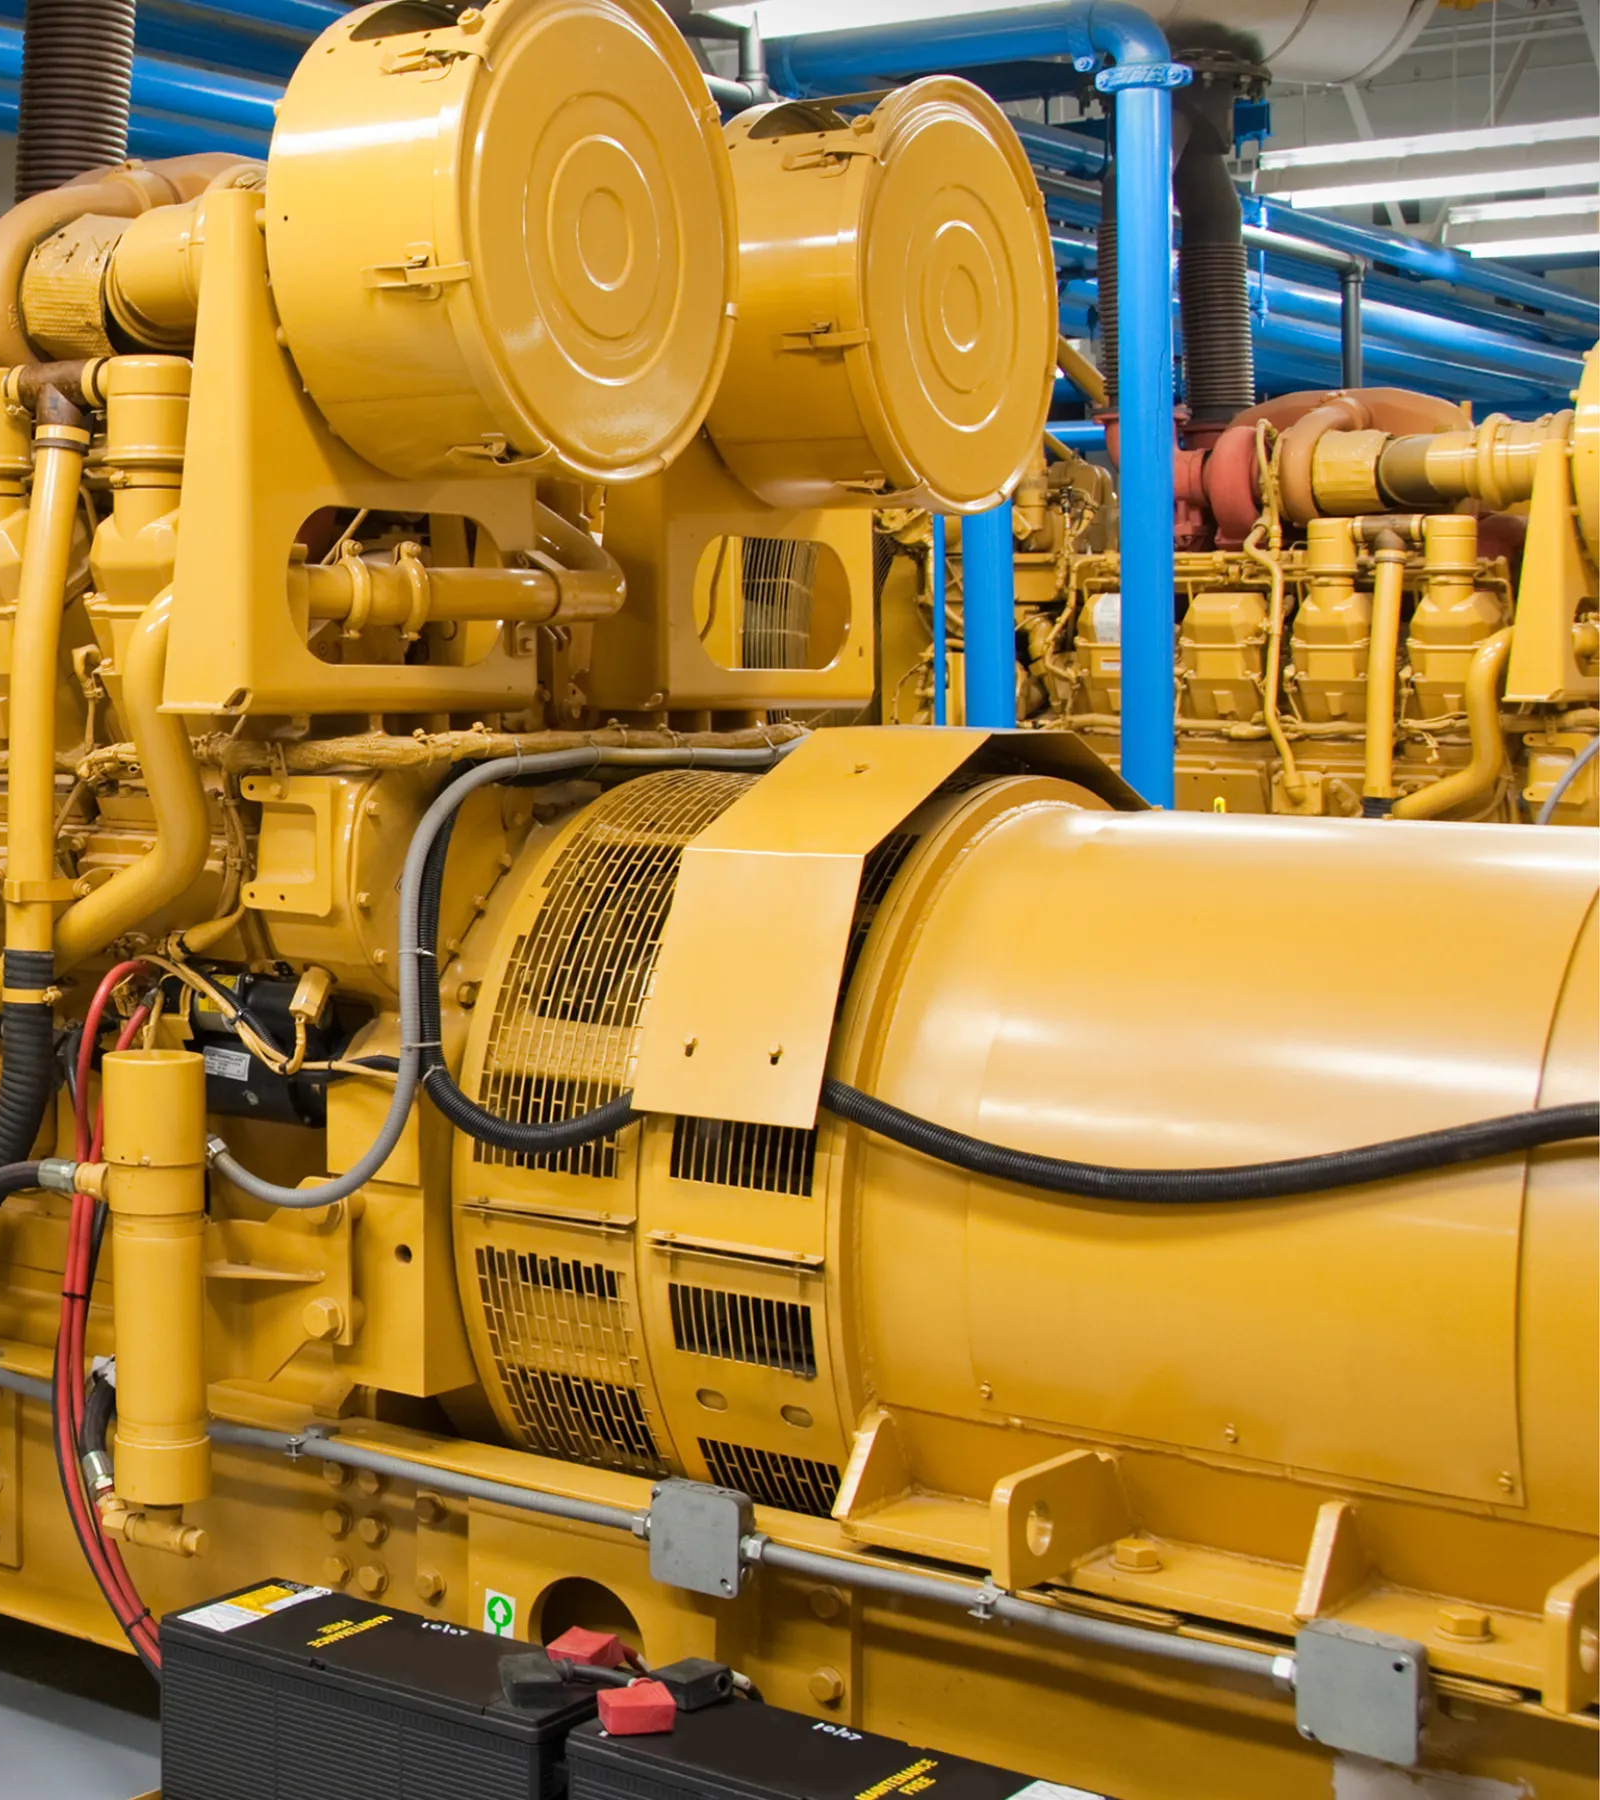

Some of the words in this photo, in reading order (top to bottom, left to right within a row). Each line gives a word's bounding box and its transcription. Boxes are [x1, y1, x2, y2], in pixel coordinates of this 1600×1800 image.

[307, 1614, 393, 1648] MAINTENANCE
[317, 1619, 353, 1635] FREE
[854, 1758, 939, 1800] MAINTENANCE
[897, 1776, 937, 1796] FREE
